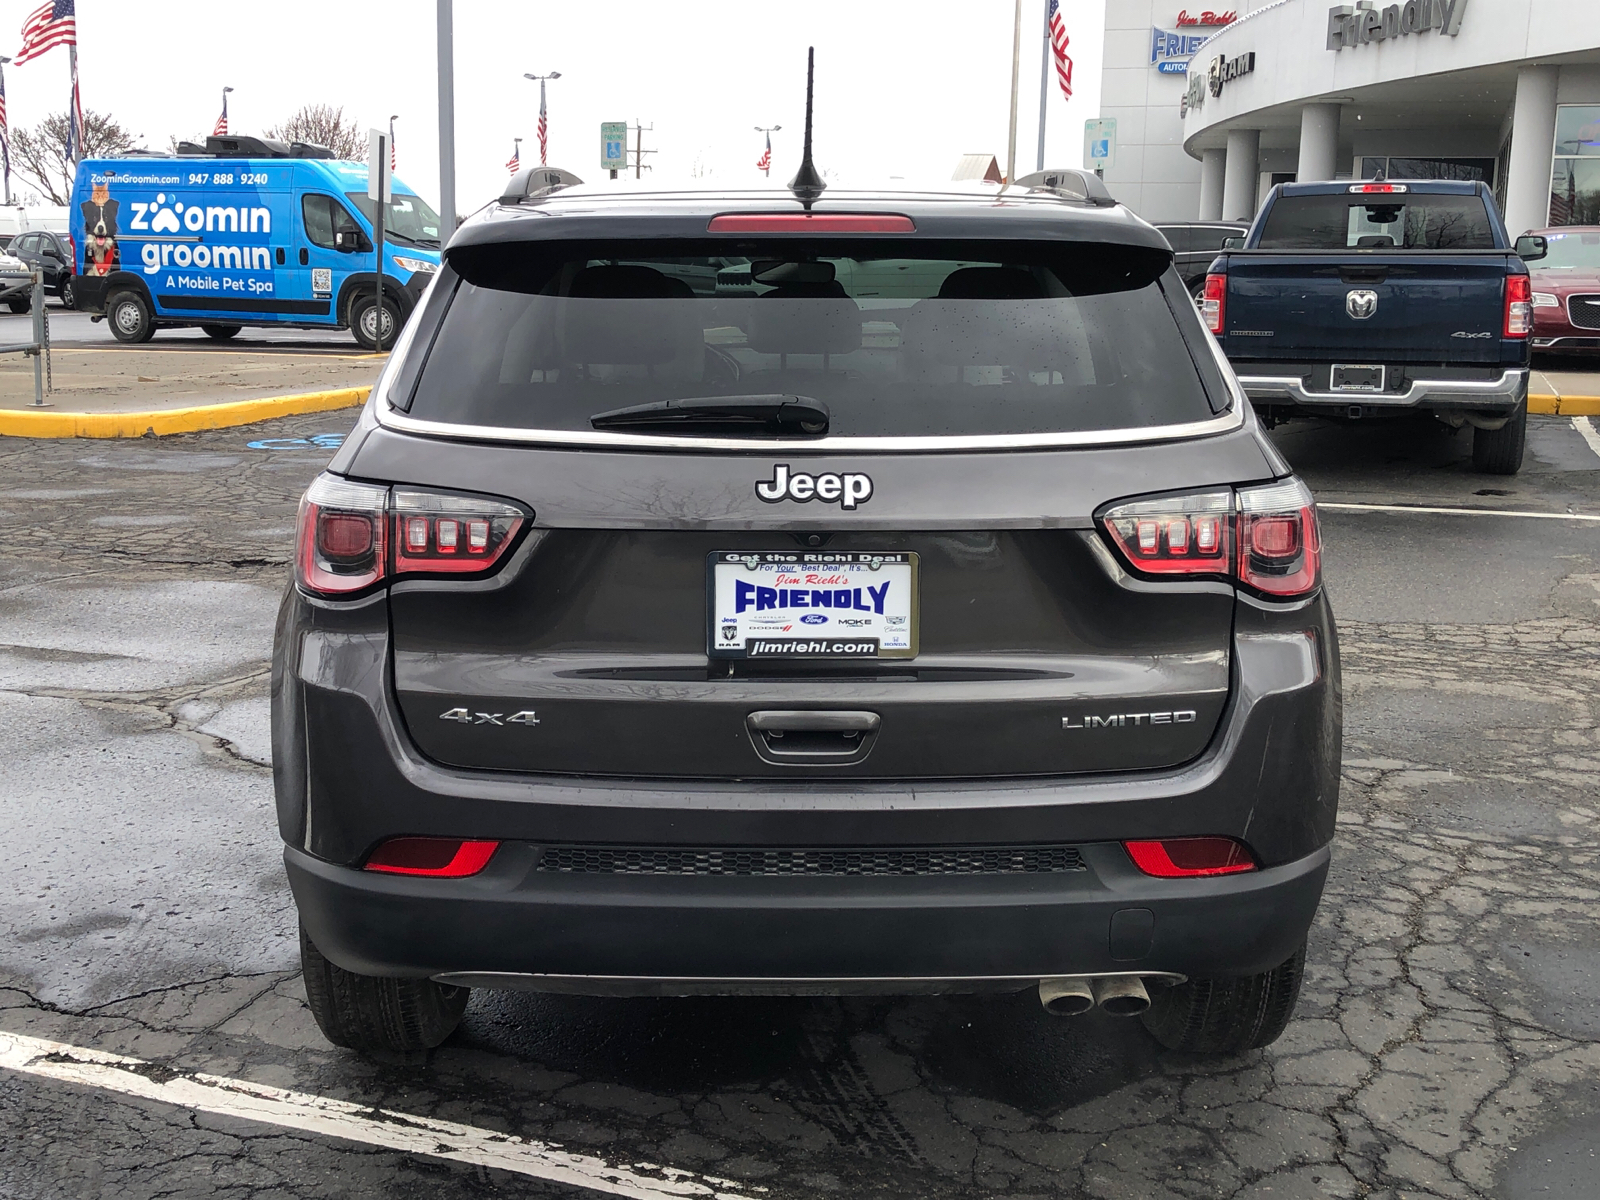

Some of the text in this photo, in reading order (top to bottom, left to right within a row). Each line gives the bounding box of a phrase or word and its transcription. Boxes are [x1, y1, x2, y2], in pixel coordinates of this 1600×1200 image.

[1176, 10, 1198, 29] Jim
[1326, 0, 1467, 50] Friendly
[1151, 25, 1210, 65] FRIE
[1220, 51, 1256, 82] RAM
[90, 173, 268, 184] ZoominGroomin.com 947 888 9240
[141, 243, 271, 274] groomin
[166, 275, 273, 294] A Mobile Pet Spa
[1450, 331, 1493, 339] 4x4
[755, 464, 874, 510] Jeep
[725, 554, 902, 562] Get the Riehl Deal
[775, 564, 797, 573] Your
[774, 574, 849, 587] Jim Riehl's
[735, 579, 891, 615] FRIENDLY
[804, 615, 824, 623] Ford
[751, 641, 875, 655] jimriehl.com
[439, 707, 540, 726] 4x4
[1061, 710, 1197, 730] LIMITED
